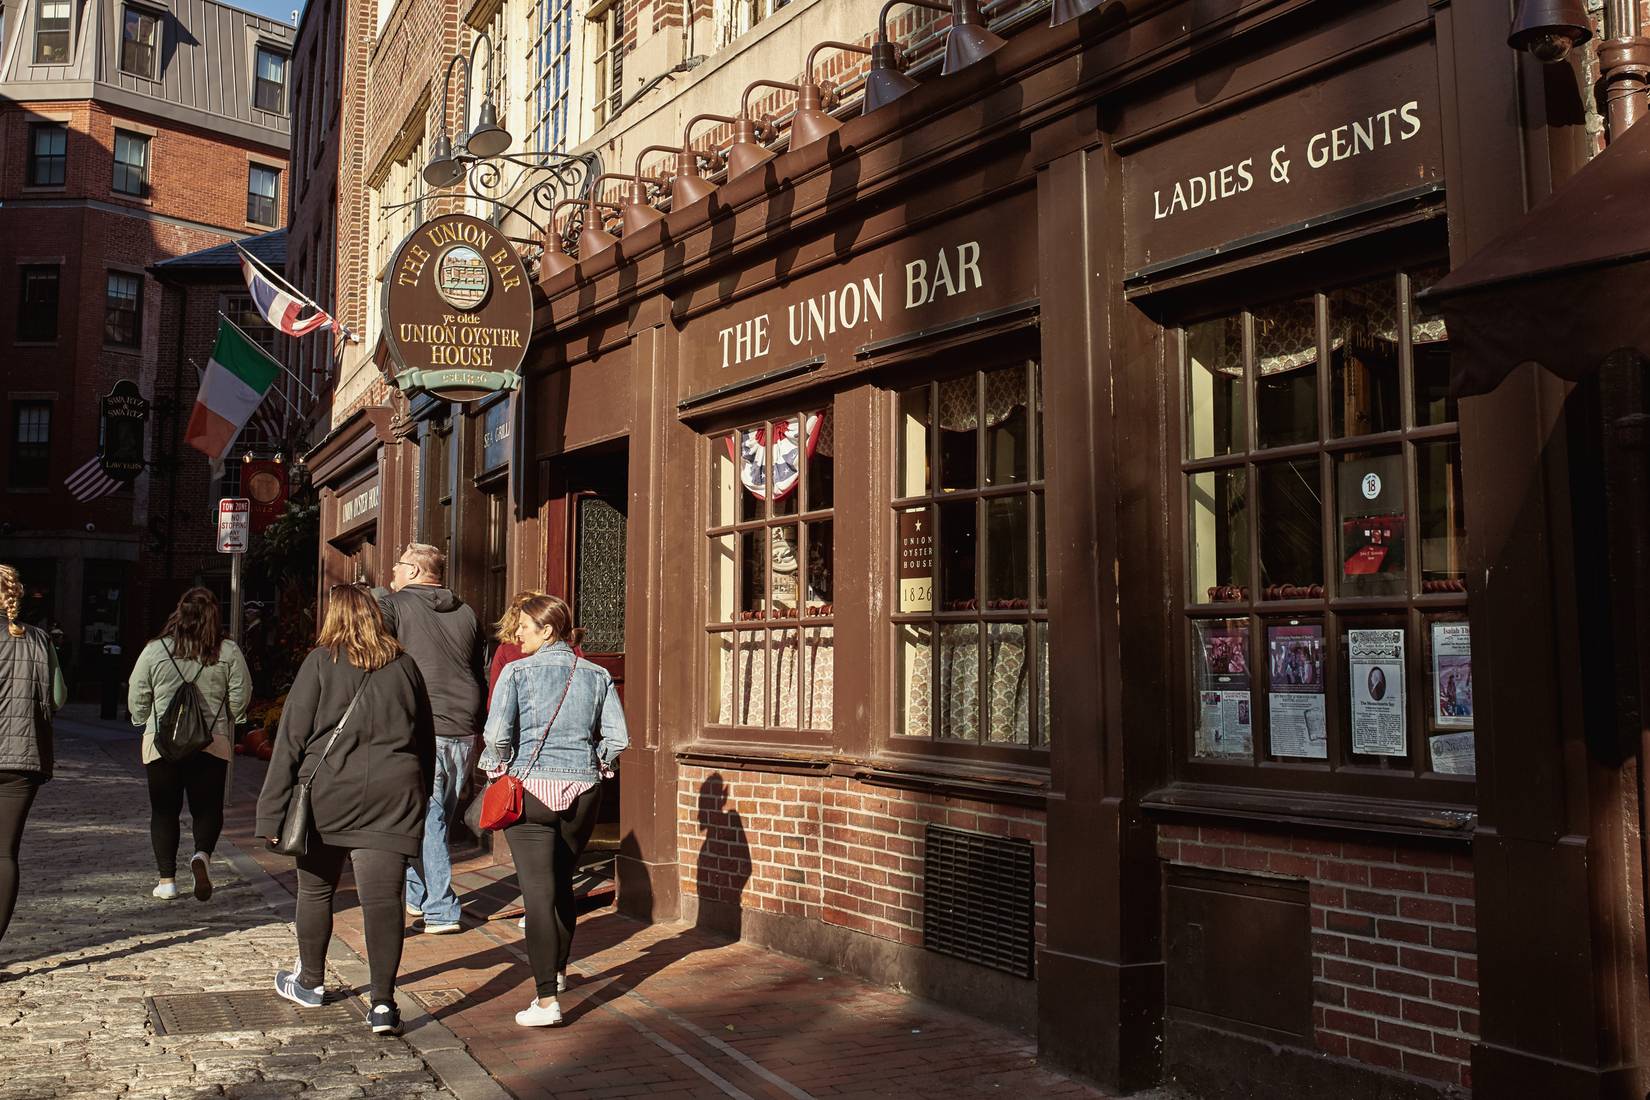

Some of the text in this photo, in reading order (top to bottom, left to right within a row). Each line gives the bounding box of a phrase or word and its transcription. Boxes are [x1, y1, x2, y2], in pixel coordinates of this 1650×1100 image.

[1153, 100, 1421, 220] LADIES & GENTS
[397, 222, 521, 293] THE UNION BAR
[718, 241, 983, 369] THE UNION BAR
[443, 313, 481, 326] ye olde
[399, 324, 522, 348] UNION OYSTER
[430, 345, 493, 366] HOUSE
[1366, 479, 1376, 492] 18
[222, 502, 234, 511] TOW
[235, 502, 248, 511] ZONE
[221, 522, 247, 530] STOPPING
[903, 536, 932, 546] UNION
[903, 547, 933, 557] OYSTER
[903, 559, 933, 569] HOUSE
[903, 586, 932, 602] 1826
